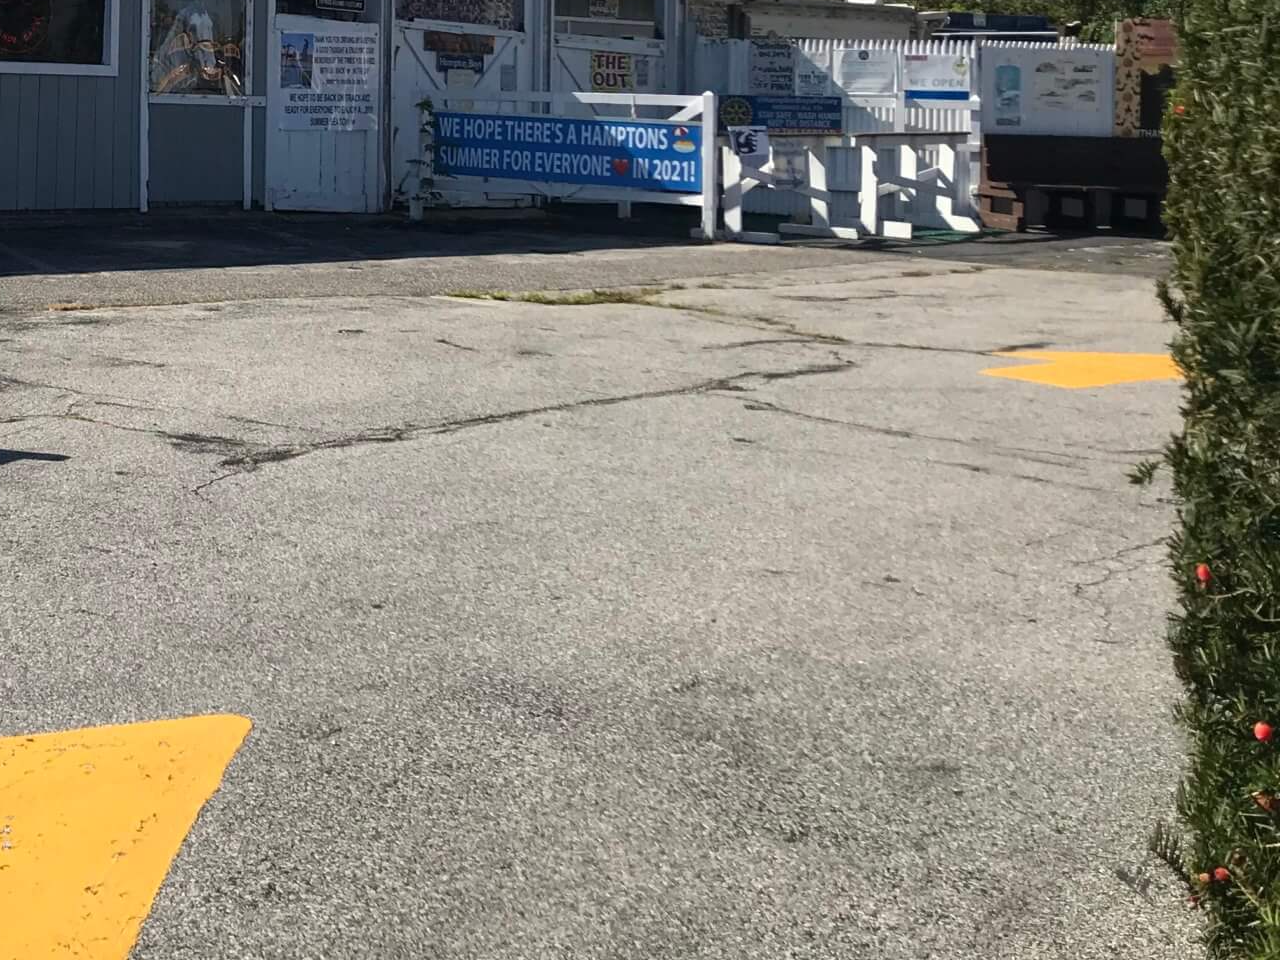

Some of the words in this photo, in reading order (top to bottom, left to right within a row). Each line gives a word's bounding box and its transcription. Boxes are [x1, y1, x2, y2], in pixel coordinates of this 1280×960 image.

[594, 54, 626, 70] THE
[593, 72, 628, 88] OUT
[932, 78, 964, 87] OPEN
[439, 117, 460, 138] WE
[464, 118, 502, 140] HOPE
[505, 120, 563, 144] THERE'S
[567, 124, 577, 144] A
[581, 125, 668, 150] HAMPTONS
[440, 145, 499, 169] SUMMER
[504, 149, 531, 172] FOR
[535, 152, 611, 177] EVERYONE
[632, 157, 649, 179] IN
[653, 159, 695, 182] 2021!
